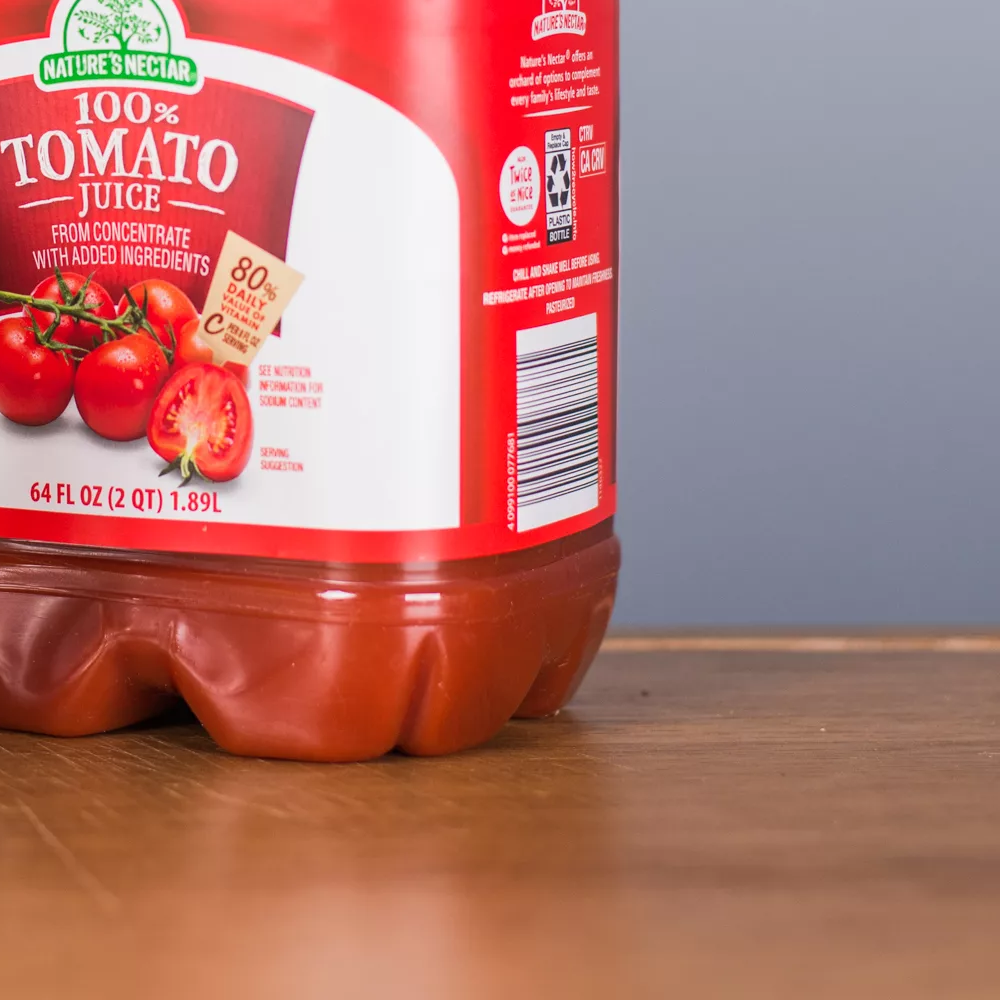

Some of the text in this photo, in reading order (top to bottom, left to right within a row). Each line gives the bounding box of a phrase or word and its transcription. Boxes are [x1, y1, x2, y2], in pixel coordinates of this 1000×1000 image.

[534, 14, 585, 36] NATURE'S NECTAR
[43, 51, 191, 82] NATURE'S NECTAR
[520, 54, 546, 68] Nature's
[571, 49, 586, 62] offers
[587, 51, 593, 60] an
[509, 67, 601, 88] orchard of options to complement
[510, 85, 600, 108] every family's lifestyle and taste.
[73, 91, 179, 125] 100%
[0, 127, 238, 193] TOMATO
[581, 147, 605, 173] CA CRV
[509, 165, 532, 185] Twice
[78, 182, 161, 217] JUICE
[518, 186, 533, 202] Nice
[549, 214, 571, 227] PLASTIC
[52, 222, 191, 249] FROM CONCENTRATE
[549, 229, 570, 242] BOTTLE
[33, 245, 211, 276] WITH ADDED INGREDIENTS
[512, 267, 529, 282] CHILL
[530, 265, 542, 278] AND
[542, 262, 559, 276] SHAKE
[559, 259, 571, 273] WELL
[571, 255, 588, 270] BEFORE
[231, 256, 278, 302] 80%
[483, 287, 528, 306] REFRIGERATE
[528, 285, 545, 299] AFTER
[545, 280, 565, 295] OPENING
[565, 278, 572, 290] TO
[572, 273, 592, 289] MAINTAIN
[223, 293, 265, 322] VALUE OF
[227, 282, 267, 311] DAILY
[546, 297, 575, 314] PASTEURIZED
[204, 313, 225, 334] C
[221, 303, 259, 331] VITAMIN
[227, 322, 239, 335] PER
[222, 333, 248, 354] SERVING
[259, 365, 311, 378] SEE NUTRITION
[259, 380, 324, 393] INFORMATION FOR
[259, 395, 322, 409] SODIUM CONTENT
[260, 447, 289, 459] SERVING
[260, 460, 304, 472] SUGGESTION
[507, 432, 515, 531] 4 099100 077681
[30, 482, 222, 513] 64 FL OZ (2 QT) 1.89L
